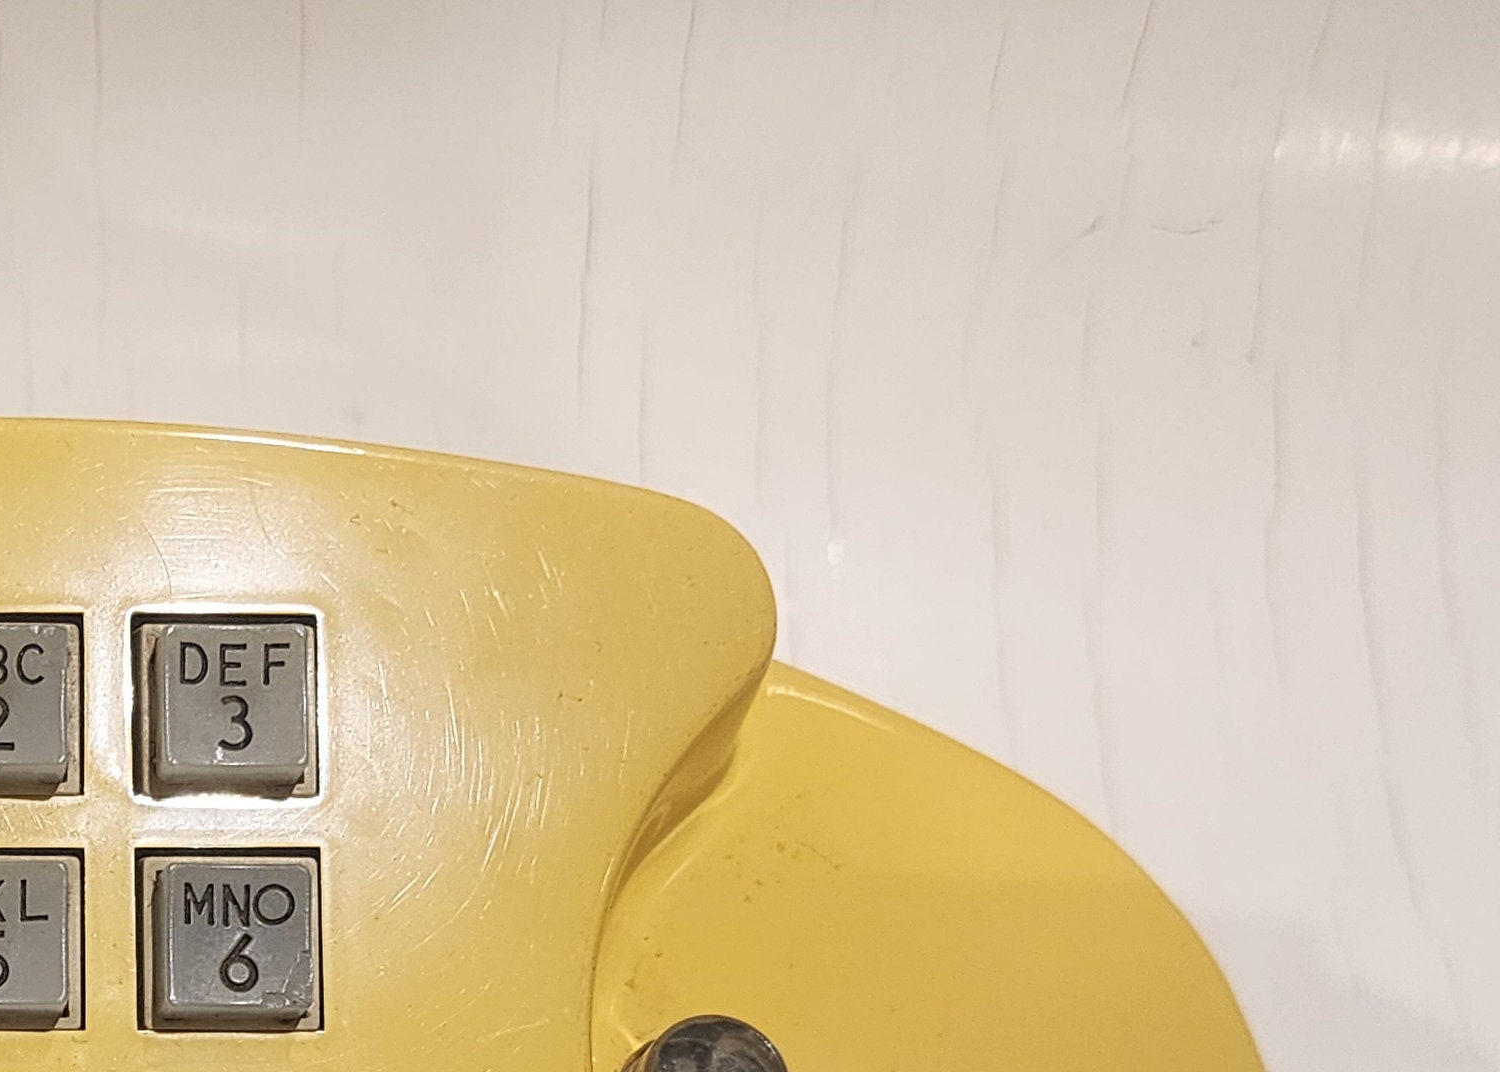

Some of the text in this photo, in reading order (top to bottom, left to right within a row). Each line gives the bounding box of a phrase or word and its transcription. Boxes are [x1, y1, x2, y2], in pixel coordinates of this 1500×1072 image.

[178, 641, 291, 687] DEF
[217, 695, 254, 751] 3
[183, 882, 295, 928] MNO
[220, 933, 259, 992] 6
